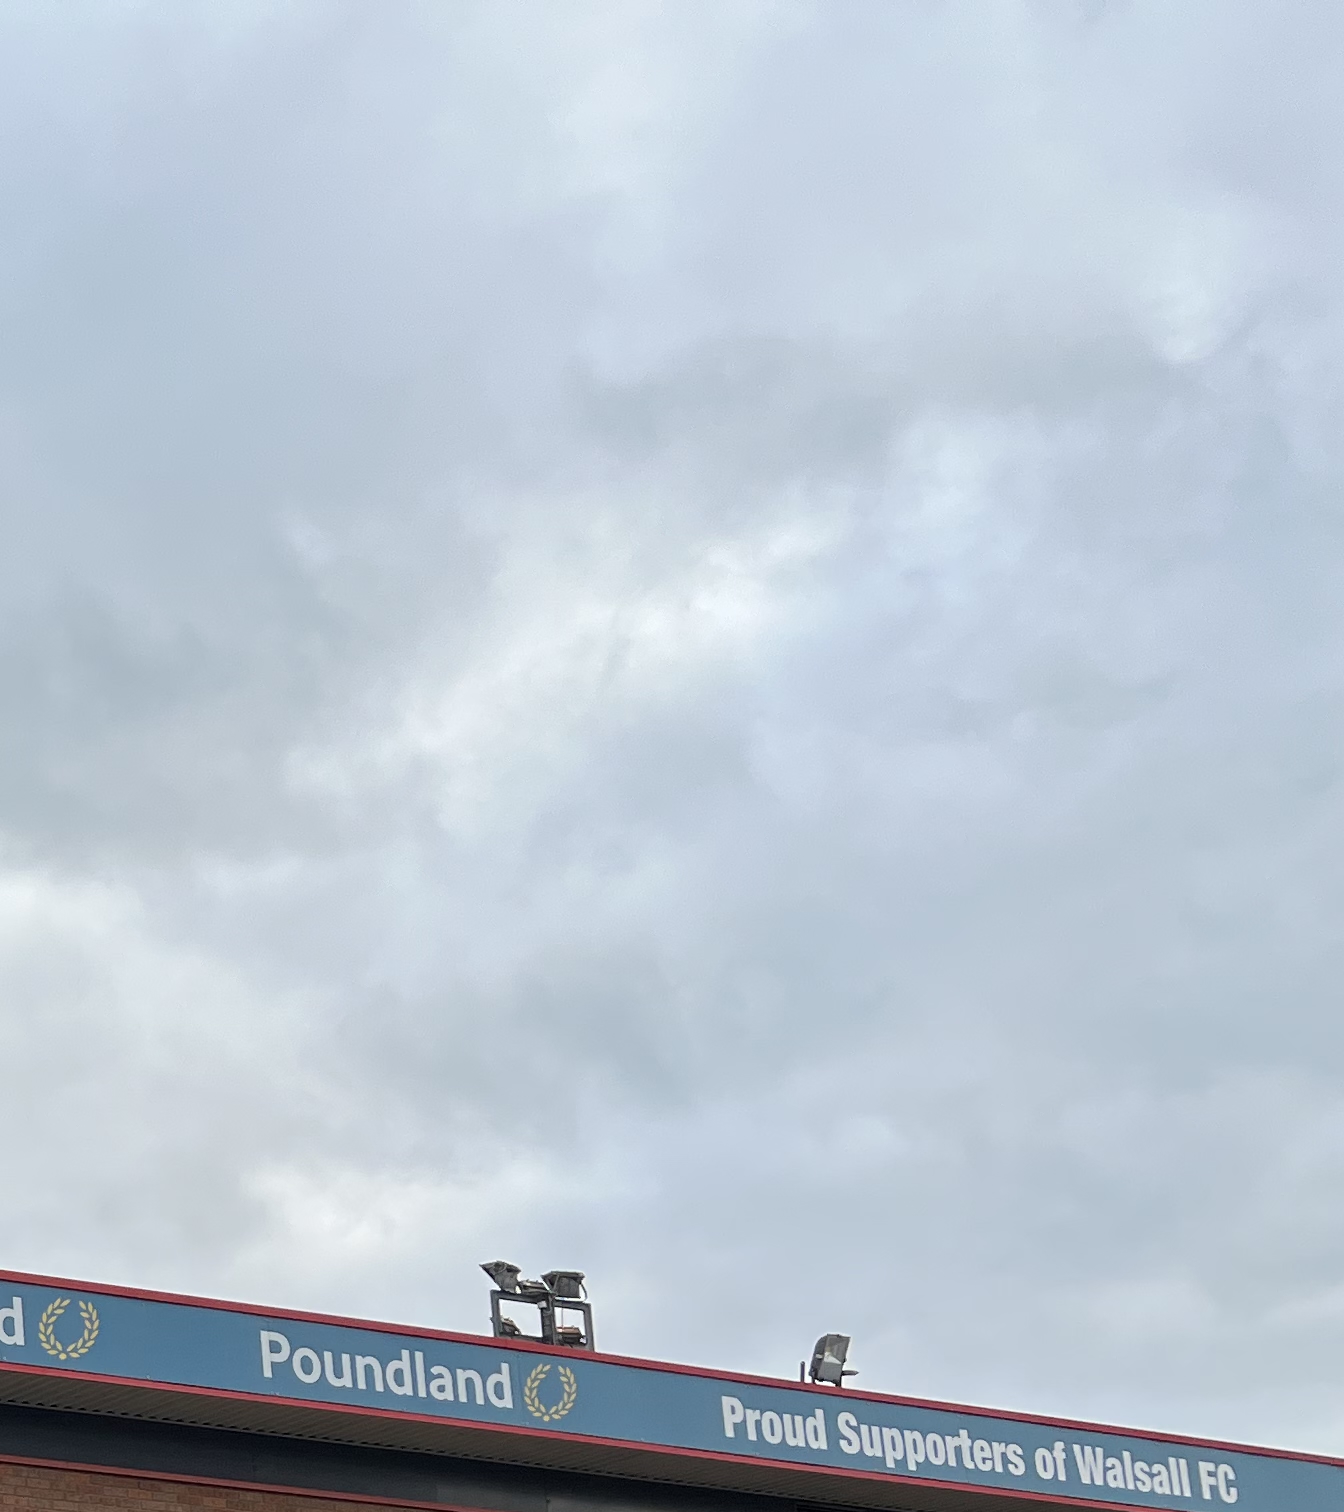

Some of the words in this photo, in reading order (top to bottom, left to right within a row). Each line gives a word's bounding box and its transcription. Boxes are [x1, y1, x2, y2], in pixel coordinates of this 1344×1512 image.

[260, 1330, 514, 1409] Poundland
[721, 1395, 828, 1450] Proud
[837, 1411, 1025, 1477] Supporters
[1034, 1440, 1067, 1482] of
[1073, 1443, 1192, 1499] Walsall
[1198, 1460, 1239, 1504] FC
